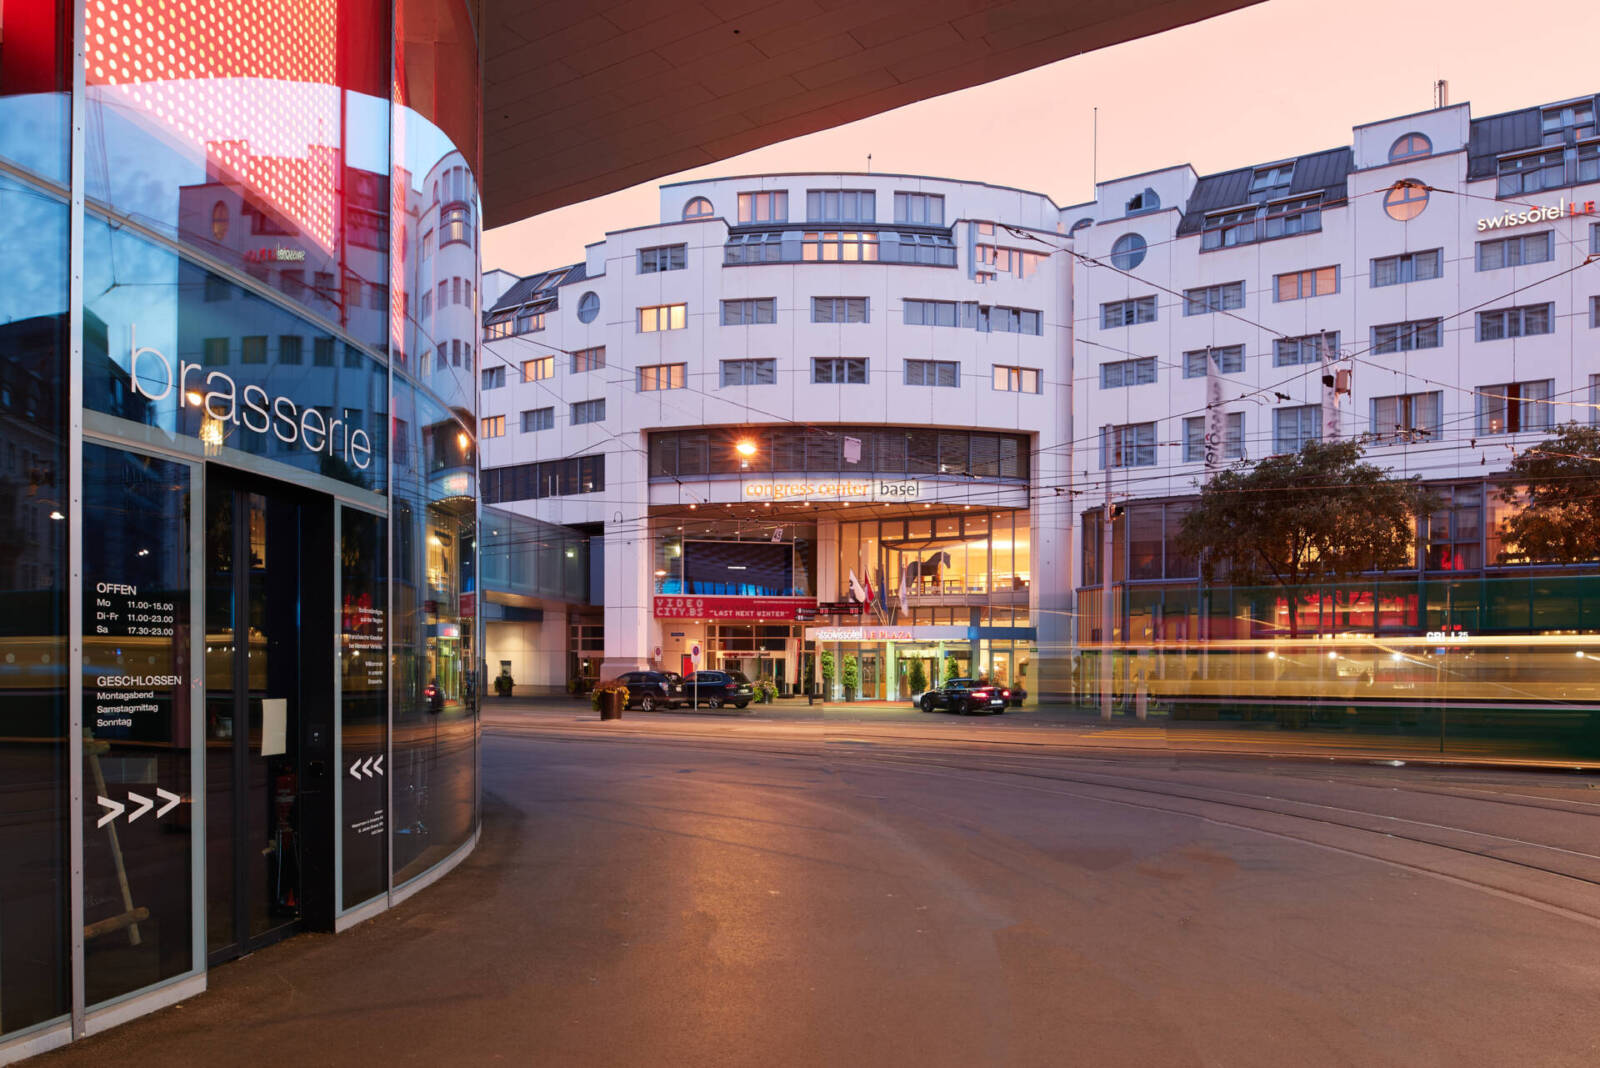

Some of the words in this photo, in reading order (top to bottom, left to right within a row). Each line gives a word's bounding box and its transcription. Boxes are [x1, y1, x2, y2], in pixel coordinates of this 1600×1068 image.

[1477, 197, 1564, 232] swissôtel
[1569, 200, 1596, 216] LE
[130, 323, 371, 469] brasserie
[745, 481, 815, 499] congress
[818, 481, 869, 496] center
[880, 480, 920, 497] basel
[96, 582, 137, 596] OFFEN
[96, 598, 111, 608] Mo
[127, 601, 174, 611] 11.00-15.00
[656, 598, 704, 608] VIDEO
[96, 611, 119, 621] Di-Fr
[127, 613, 174, 623] 11.00-23.00
[96, 625, 109, 634] Sa
[127, 626, 174, 636] 17.30-23.00
[97, 675, 182, 687] GESCHLOSSEN
[97, 691, 154, 701] Montagabend
[97, 704, 158, 714] Samstagmittag
[97, 718, 132, 727] Sonntag
